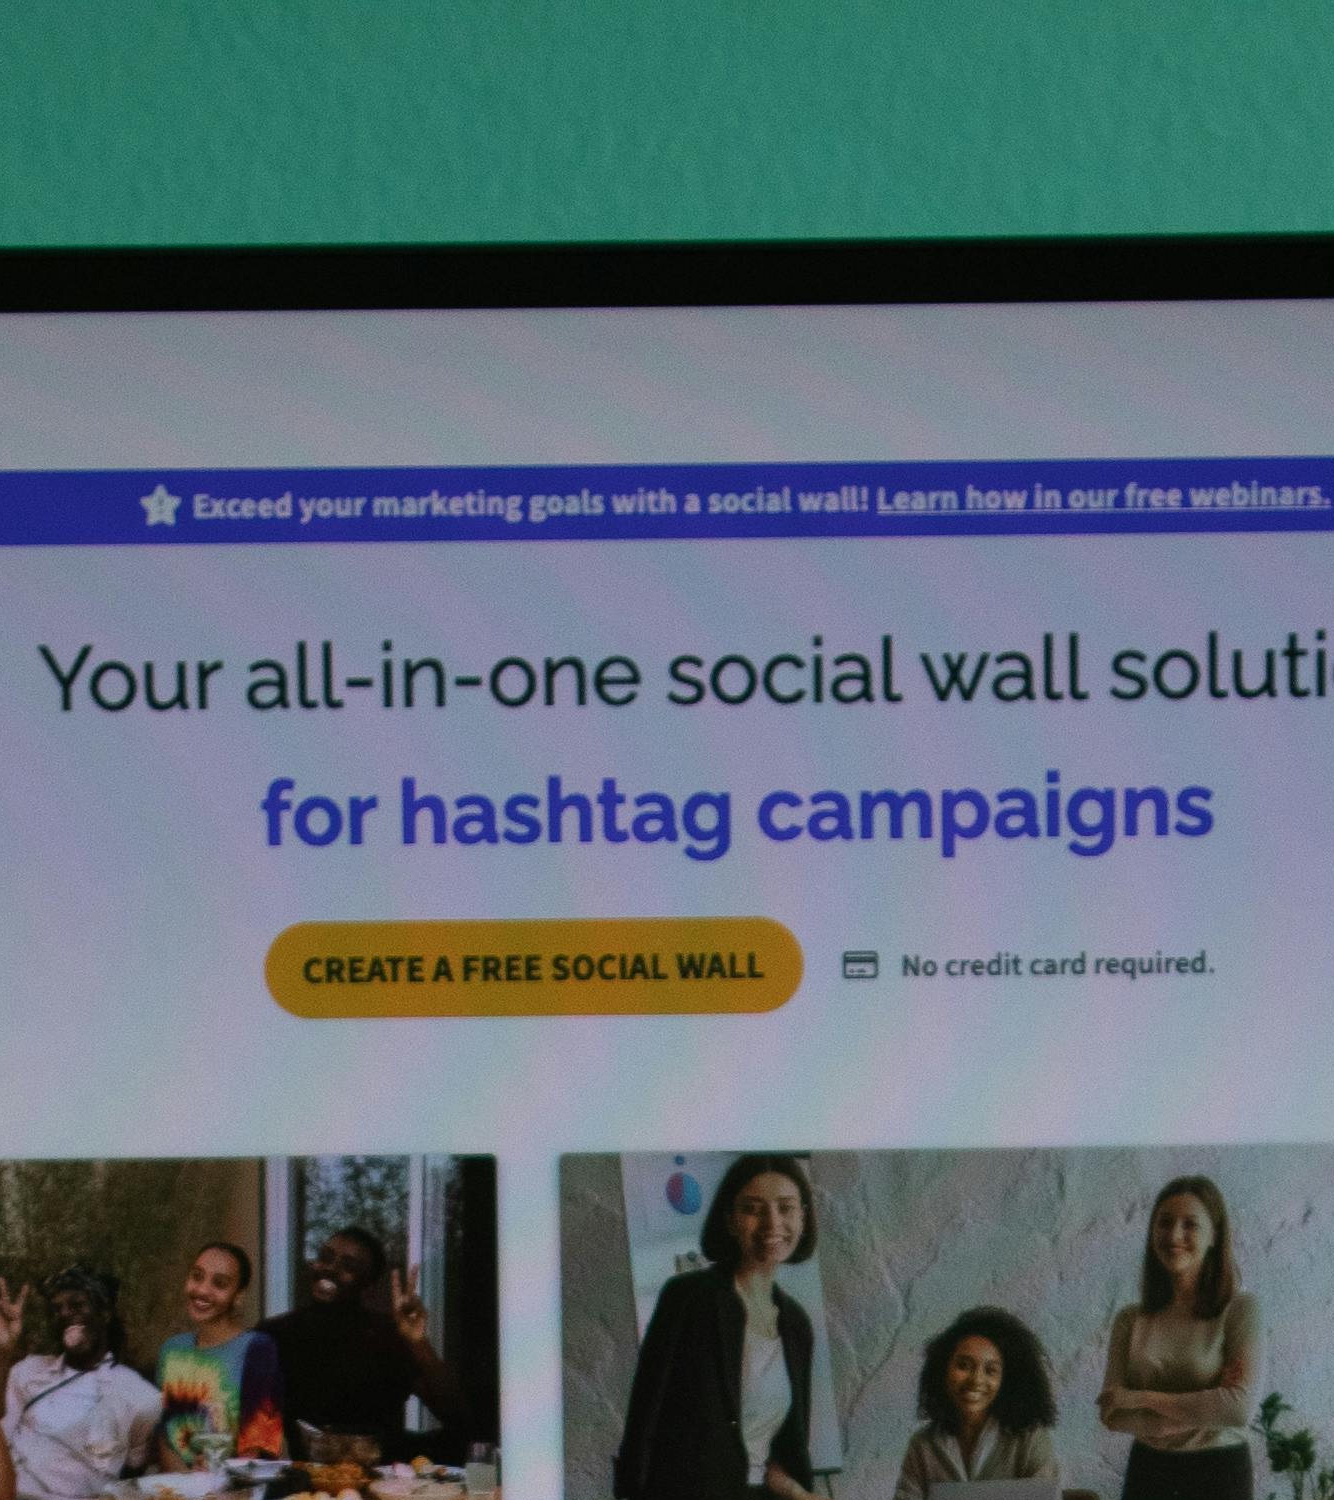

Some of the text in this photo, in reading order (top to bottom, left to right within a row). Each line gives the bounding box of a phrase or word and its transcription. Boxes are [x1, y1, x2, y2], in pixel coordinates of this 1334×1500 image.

[192, 485, 869, 525] Exceed your marketing goals with a social wall!
[876, 479, 1331, 513] Learn how in our free webinars.
[37, 644, 224, 713] Your
[245, 638, 642, 712] all-in-one
[667, 634, 903, 706] social
[919, 631, 1090, 703] wall
[259, 768, 1215, 862] for hashtag campaigns
[302, 952, 765, 985] CREATE A FREE SOCIAL WALL
[901, 949, 1215, 982] No credit card required.
